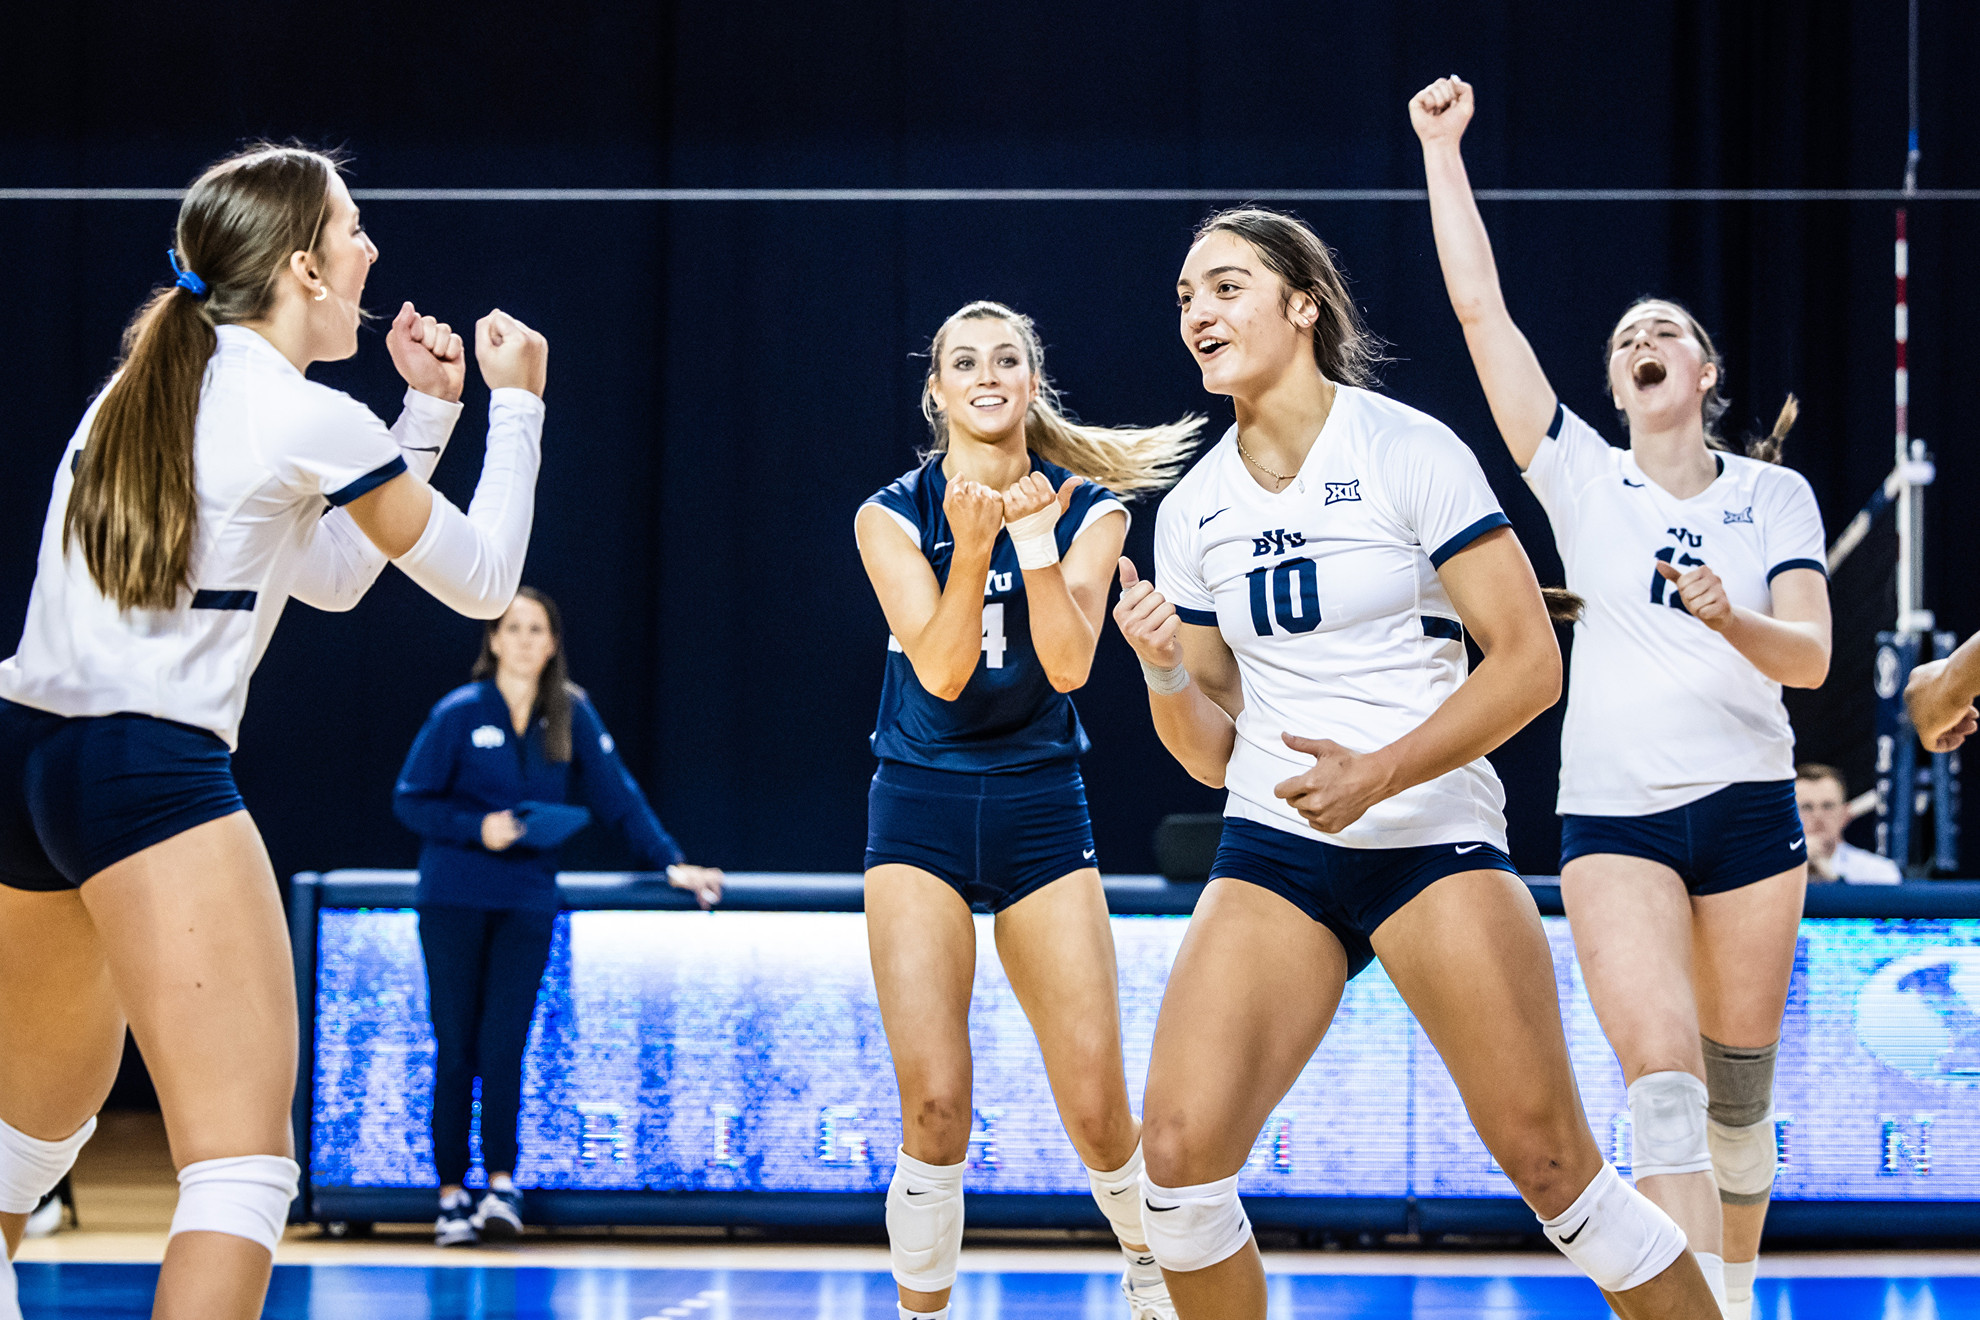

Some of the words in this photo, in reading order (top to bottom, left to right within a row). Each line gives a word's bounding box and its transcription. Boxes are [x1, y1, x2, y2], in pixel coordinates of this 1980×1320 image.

[1252, 528, 1306, 557] BYU
[1666, 527, 1703, 548] YU
[984, 569, 1013, 596] YU
[1245, 556, 1322, 637] 10
